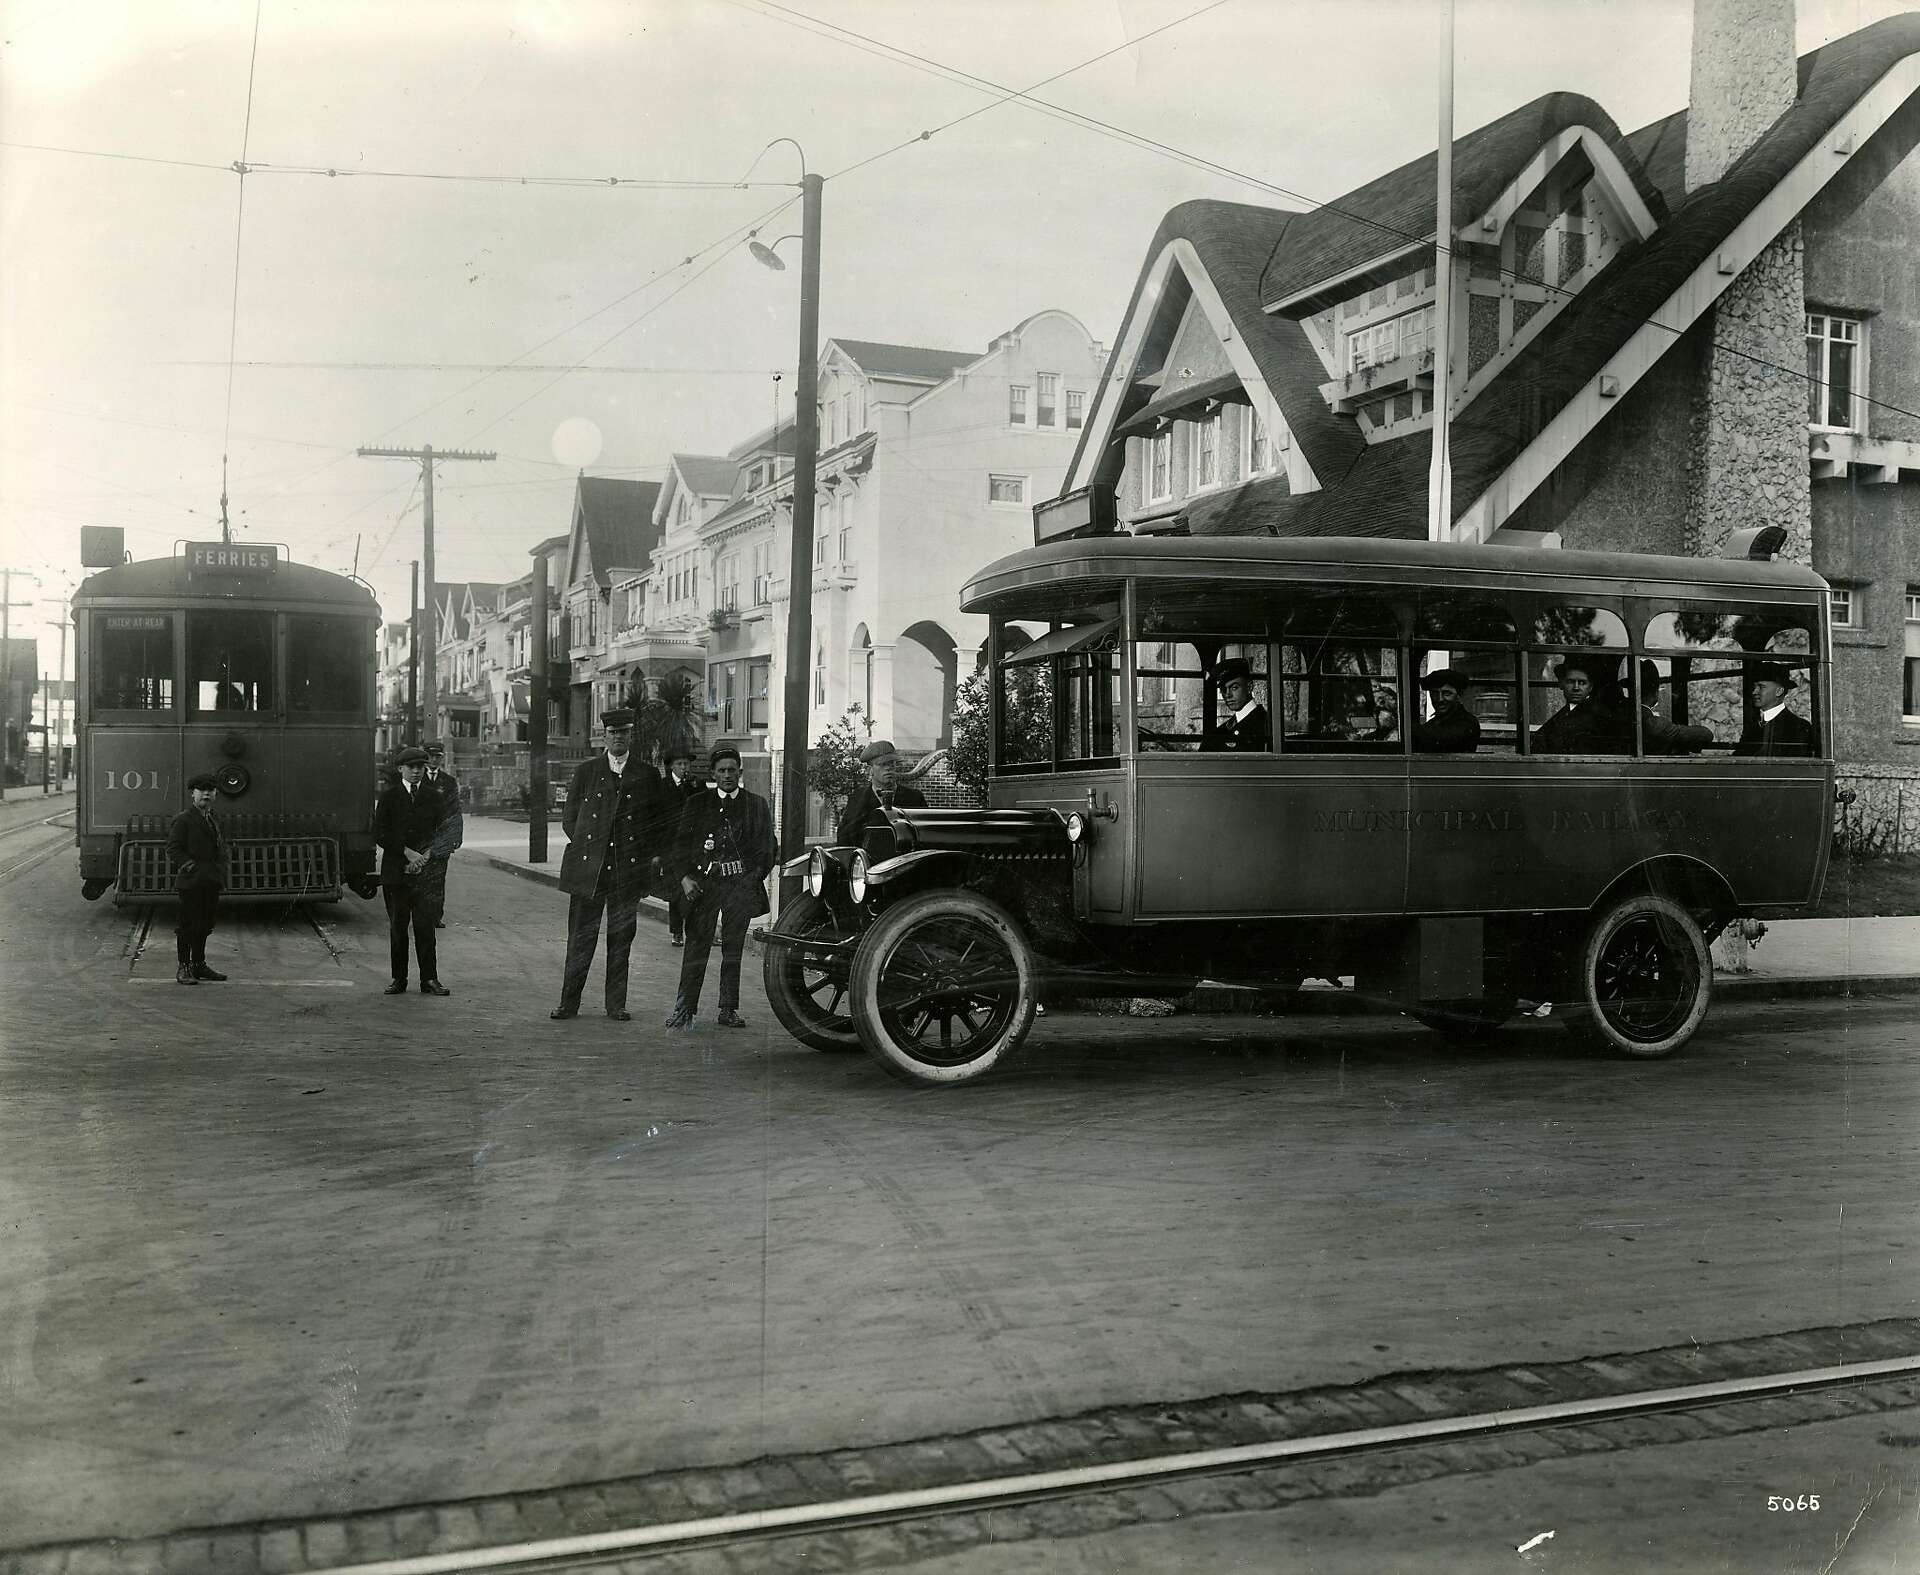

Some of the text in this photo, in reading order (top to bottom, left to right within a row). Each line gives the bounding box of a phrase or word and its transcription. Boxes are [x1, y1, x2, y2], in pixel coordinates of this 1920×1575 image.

[195, 550, 271, 567] FERRIES
[107, 617, 164, 628] ENTER AT REAR
[106, 771, 160, 790] 101
[1313, 810, 1693, 833] MUNICIPAL RAILWAY
